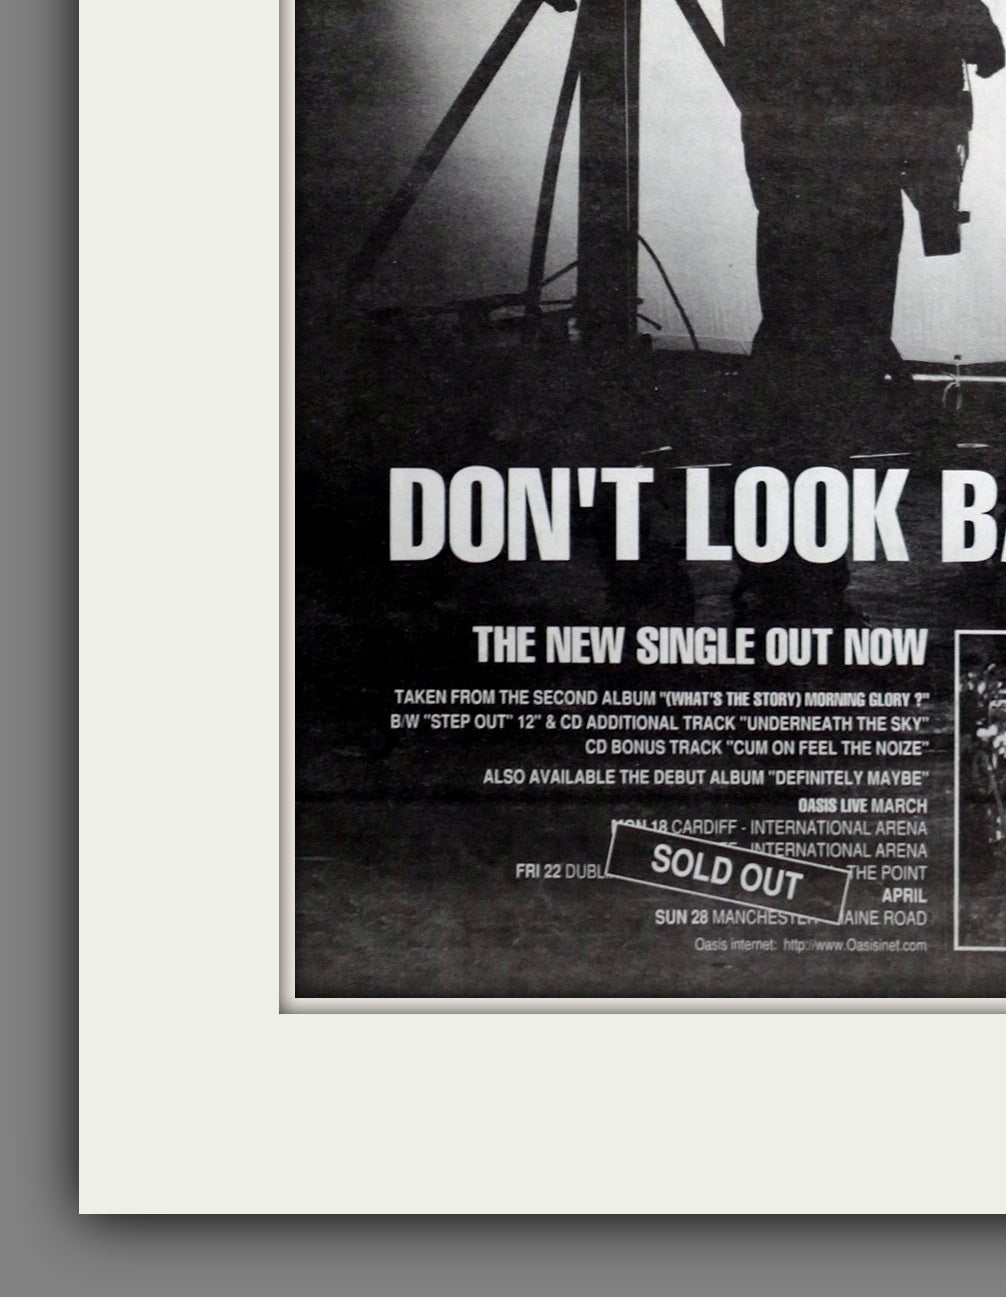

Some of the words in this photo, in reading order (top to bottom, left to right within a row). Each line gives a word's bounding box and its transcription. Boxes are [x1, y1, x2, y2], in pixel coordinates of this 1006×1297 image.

[389, 466, 654, 563] DON'T
[685, 465, 910, 563] LOOK
[472, 625, 536, 663] THE
[546, 626, 625, 664] NEW
[636, 626, 755, 666] SINGLE
[765, 627, 833, 667] OUT
[844, 627, 928, 666] NOW
[394, 689, 447, 705] TAKEN
[450, 689, 495, 705] FROM
[499, 689, 530, 705] THE
[533, 689, 598, 706] SECOND
[601, 690, 656, 706] ALBUM
[659, 691, 723, 707] "(WHAT'S
[726, 691, 750, 707] THE
[753, 691, 801, 708] STORY)
[804, 691, 866, 708] MORNING
[868, 691, 911, 708] GLORY
[390, 713, 420, 729] B/W
[423, 713, 471, 729] "STEP
[474, 713, 513, 729] OUT"
[518, 714, 542, 729] 12"
[545, 714, 556, 730] &
[560, 714, 583, 730] CD
[586, 715, 679, 731] ADDITIONAL
[682, 715, 736, 731] TRACK
[739, 715, 852, 732] "UNDERNEATH
[856, 716, 888, 732] THE
[890, 716, 930, 732] SKY"
[585, 739, 607, 755] CD
[611, 739, 666, 755] BONUS
[669, 739, 722, 755] TRACK
[726, 740, 768, 756] "CUM
[771, 740, 795, 756] ON
[798, 740, 838, 756] FEEL
[841, 740, 872, 756] THE
[875, 740, 930, 756] NOIZE"
[483, 769, 526, 785] ALSO
[529, 769, 616, 785] AVAILABLE
[619, 769, 650, 785] THE
[653, 769, 706, 785] DEBUT
[709, 769, 765, 786] ALBUM
[768, 769, 864, 786] "DEFINITELY
[867, 770, 930, 786] MAYBE"
[798, 798, 838, 814] OASIS
[840, 798, 868, 814] LIVE
[870, 798, 928, 814] MARCH
[671, 819, 738, 835] CARDIFF
[750, 819, 872, 836] INTERNATIONAL
[875, 819, 928, 836] ARENA
[875, 842, 928, 858] ARENA
[516, 863, 540, 879] FRI
[544, 863, 562, 879] 22
[846, 864, 877, 880] THE
[881, 864, 928, 881] POINT
[651, 843, 733, 885] SOLD
[740, 862, 804, 900] OUT
[881, 887, 928, 903] APRIL
[654, 908, 688, 925] SUN
[690, 908, 709, 925] 28
[883, 910, 928, 926] ROAD
[694, 937, 728, 952] Oasis
